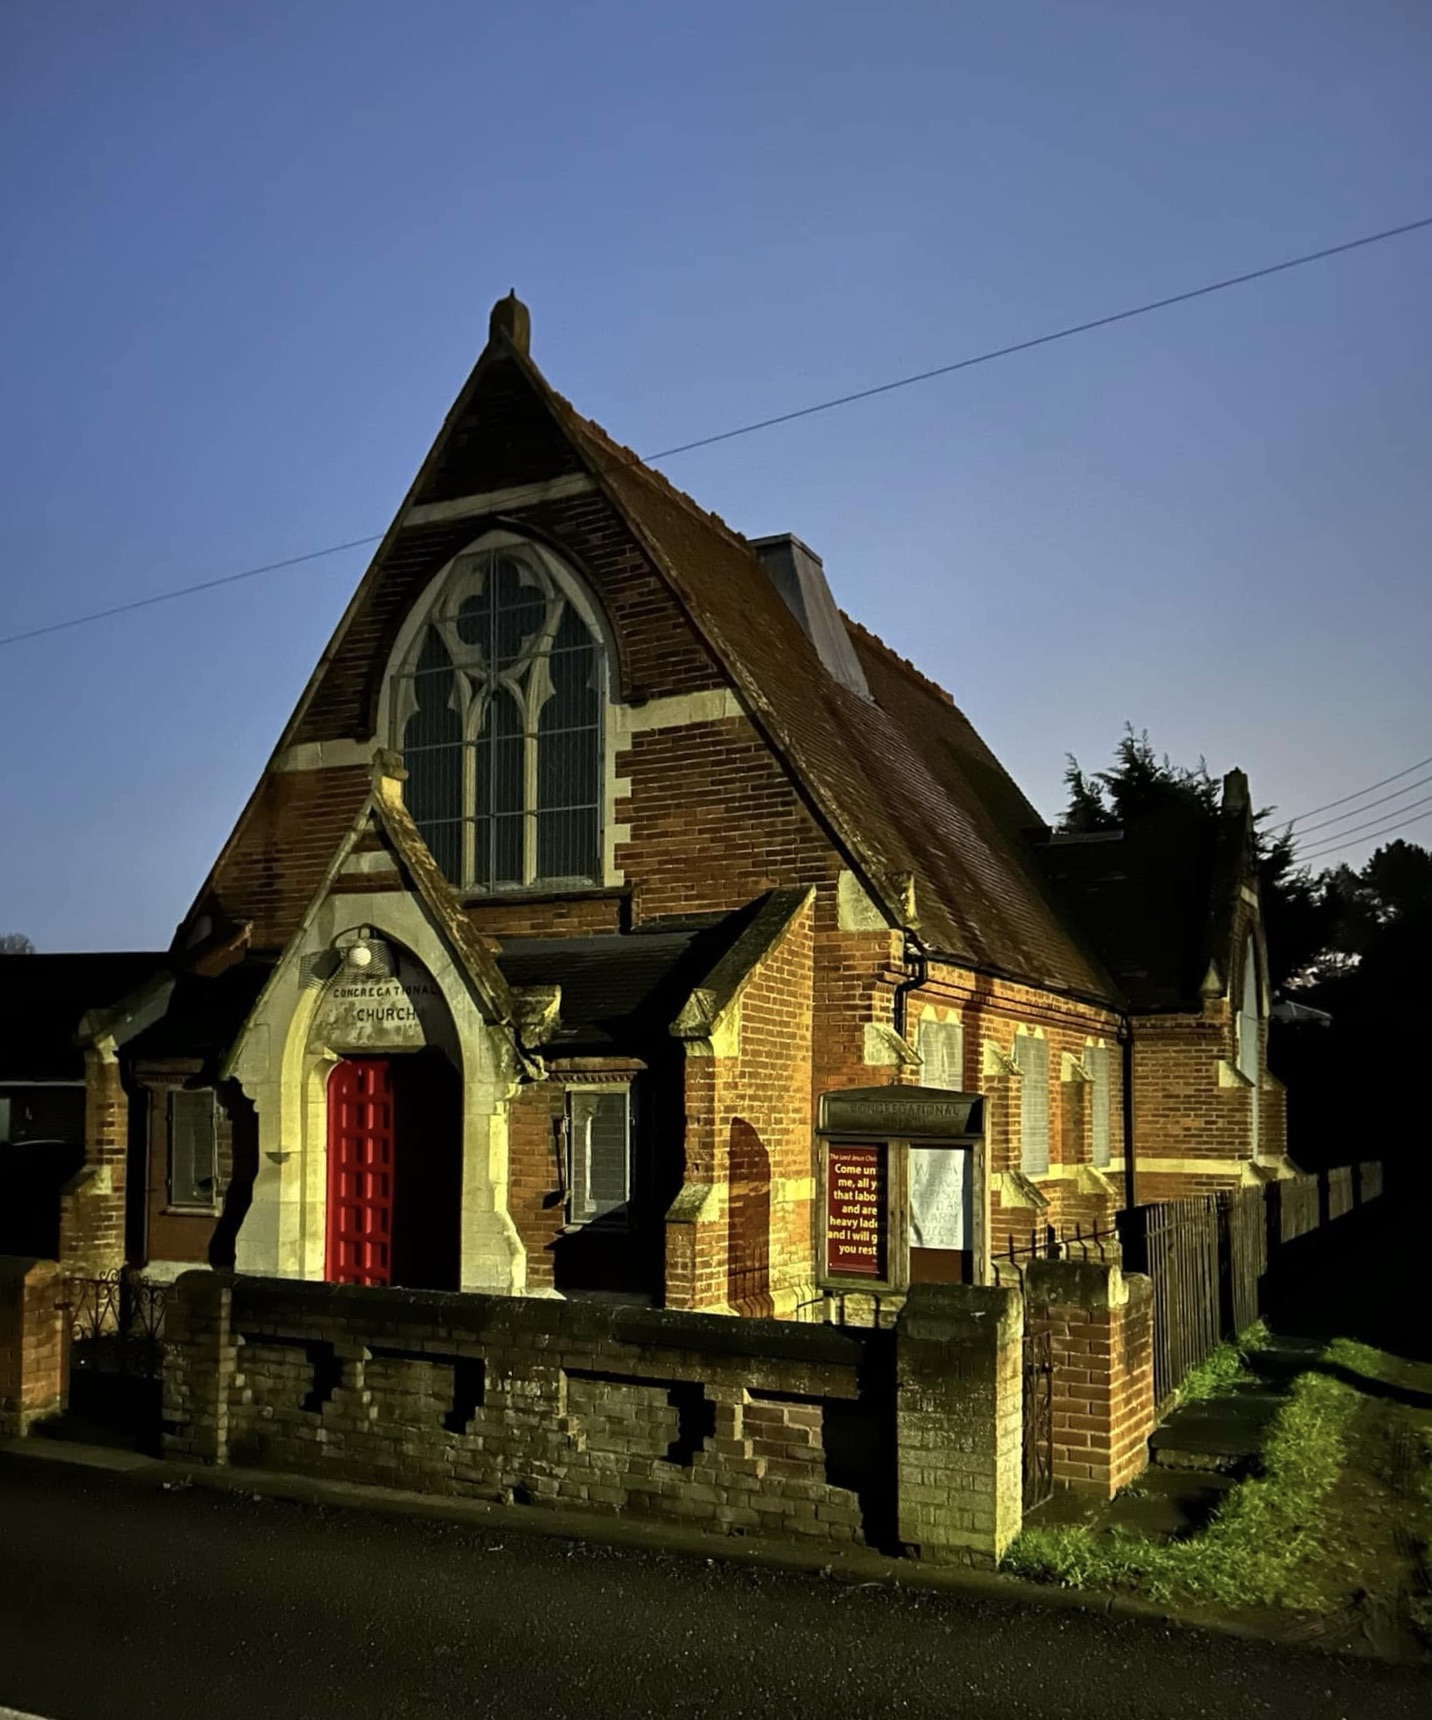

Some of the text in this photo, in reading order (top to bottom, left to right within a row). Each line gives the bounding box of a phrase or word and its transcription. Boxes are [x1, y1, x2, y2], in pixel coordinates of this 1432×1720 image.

[333, 985, 436, 999] CONGREGATIONAL
[356, 1008, 416, 1022] CHURCH
[834, 1162, 862, 1174] Come
[837, 1178, 856, 1189] me,
[857, 1176, 870, 1188] all
[833, 1189, 854, 1201] that
[841, 1203, 878, 1216] and are
[829, 1215, 858, 1230] heavy
[828, 1228, 846, 1240] and
[846, 1229, 851, 1240] I
[852, 1230, 870, 1242] will
[838, 1244, 857, 1256] you
